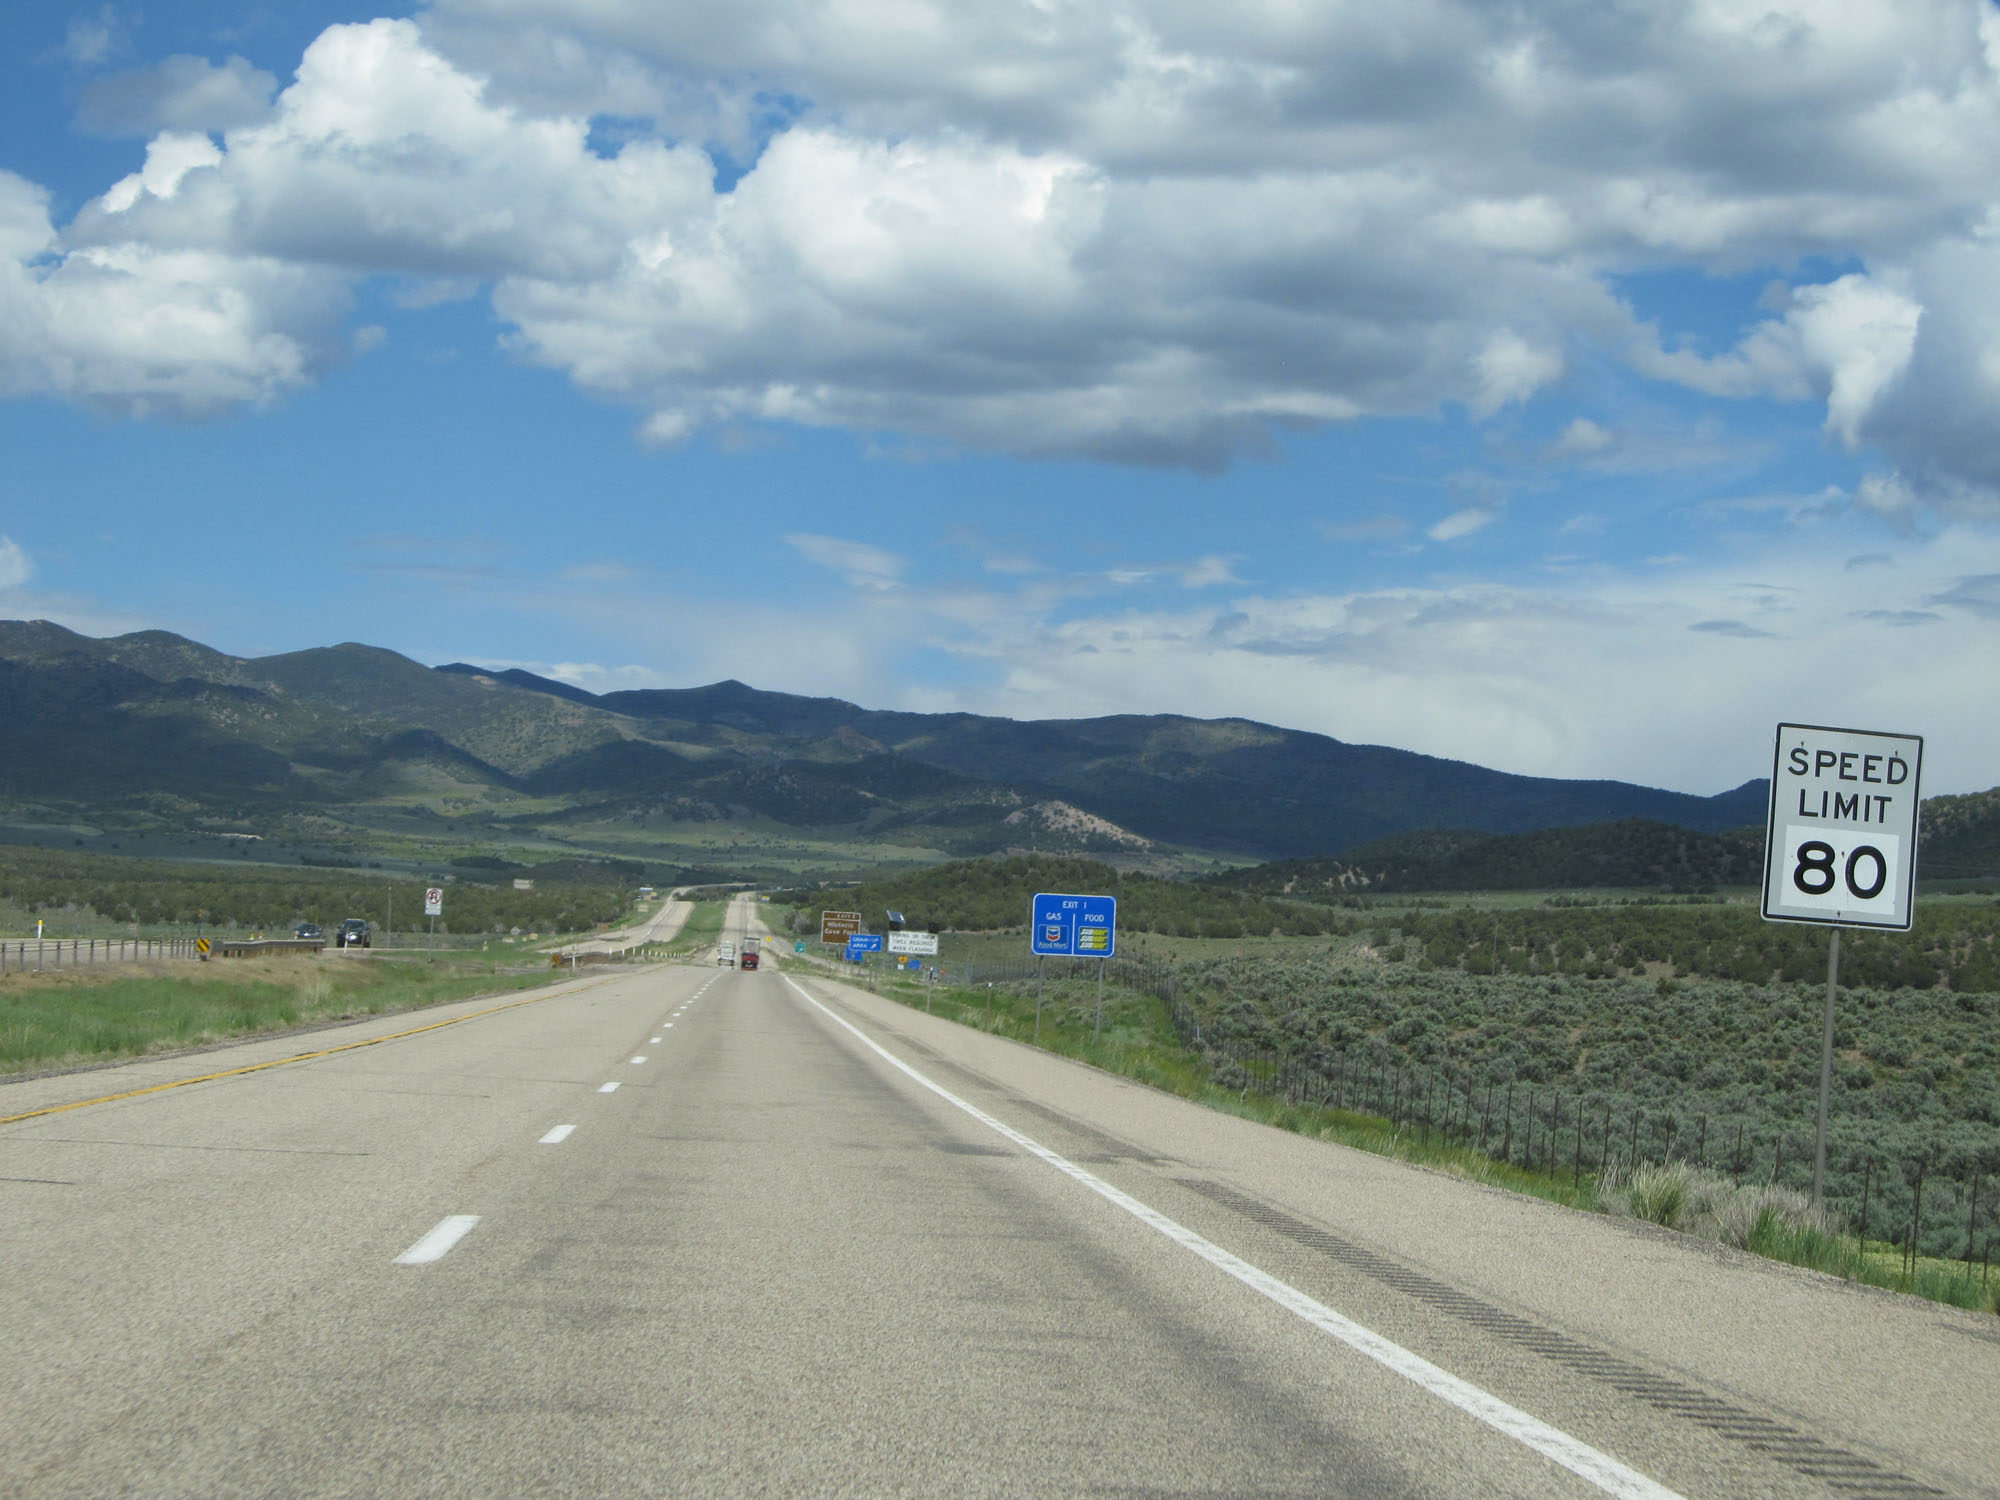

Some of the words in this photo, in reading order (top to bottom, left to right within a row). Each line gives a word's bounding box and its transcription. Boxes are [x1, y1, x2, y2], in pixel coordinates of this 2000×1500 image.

[1787, 747, 1908, 785] SPEED
[1799, 788, 1892, 823] LIMIT
[1793, 840, 1887, 900] 80
[1062, 901, 1079, 909] EXIT
[1046, 912, 1062, 921] GAS
[1084, 914, 1104, 922] FOOD
